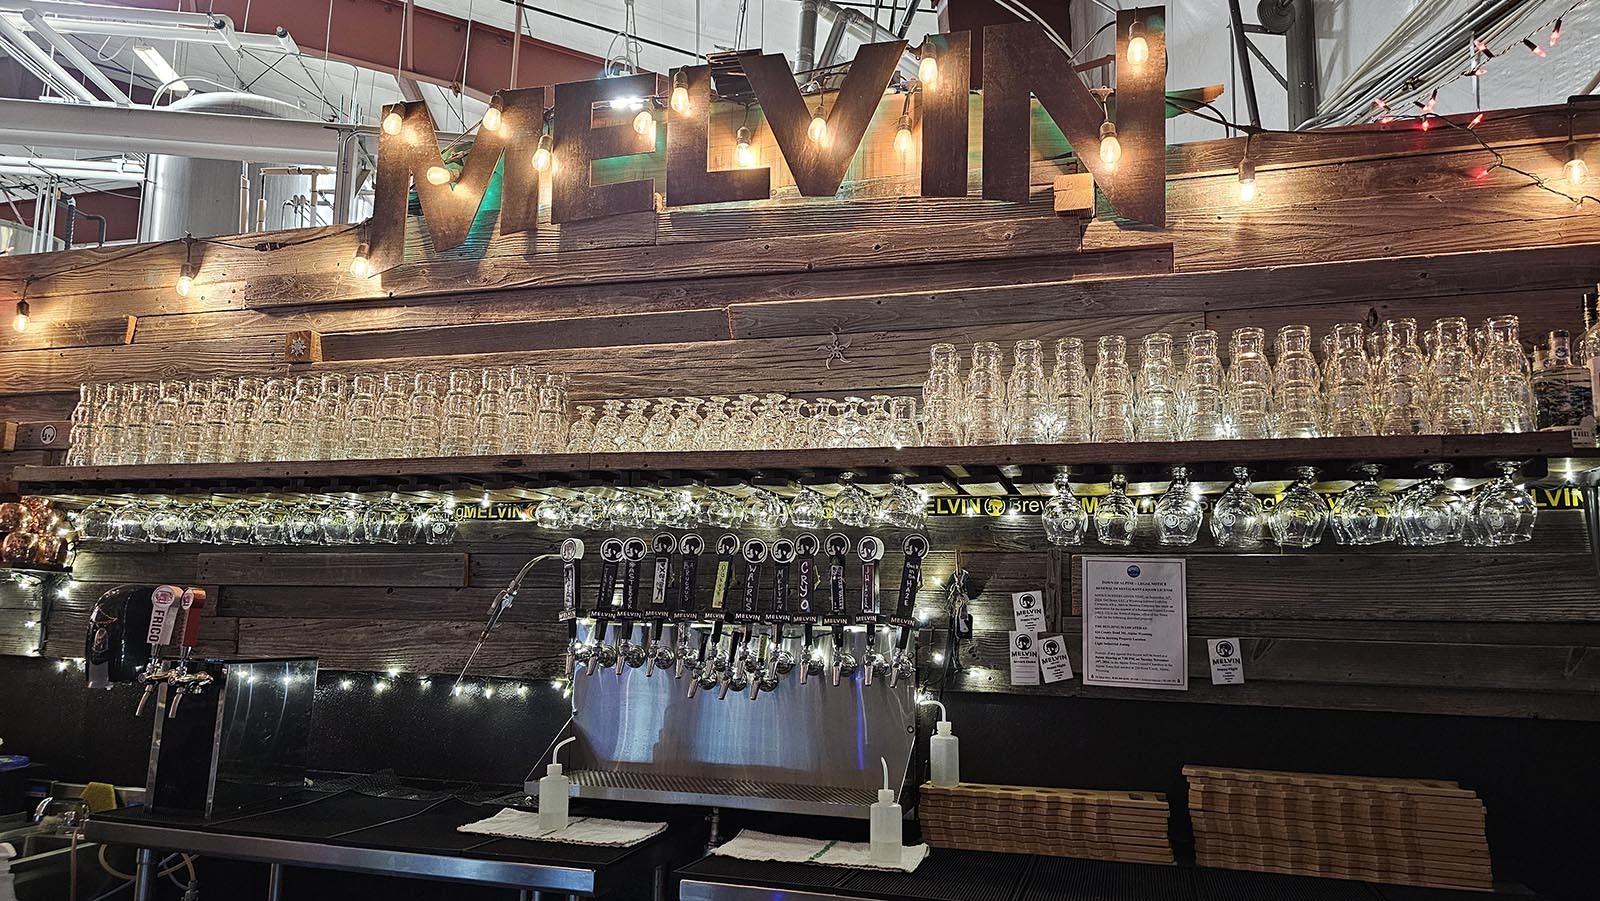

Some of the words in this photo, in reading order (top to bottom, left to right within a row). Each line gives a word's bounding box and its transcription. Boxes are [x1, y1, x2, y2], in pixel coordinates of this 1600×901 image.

[368, 6, 1166, 277] MELVIN
[746, 564, 757, 612] WALRUS
[903, 581, 912, 607] HAZE
[591, 611, 616, 619] MELVIN
[616, 611, 642, 619] MELVIN
[673, 612, 698, 620] MELVIN
[705, 612, 725, 620] MELVIN
[735, 613, 761, 621] MELVIN
[765, 613, 791, 621] MELVIN
[824, 617, 848, 625] MELVIN
[890, 617, 916, 626] MELVIN
[148, 609, 165, 642] FRICO
[1042, 655, 1067, 664] MELVIN
